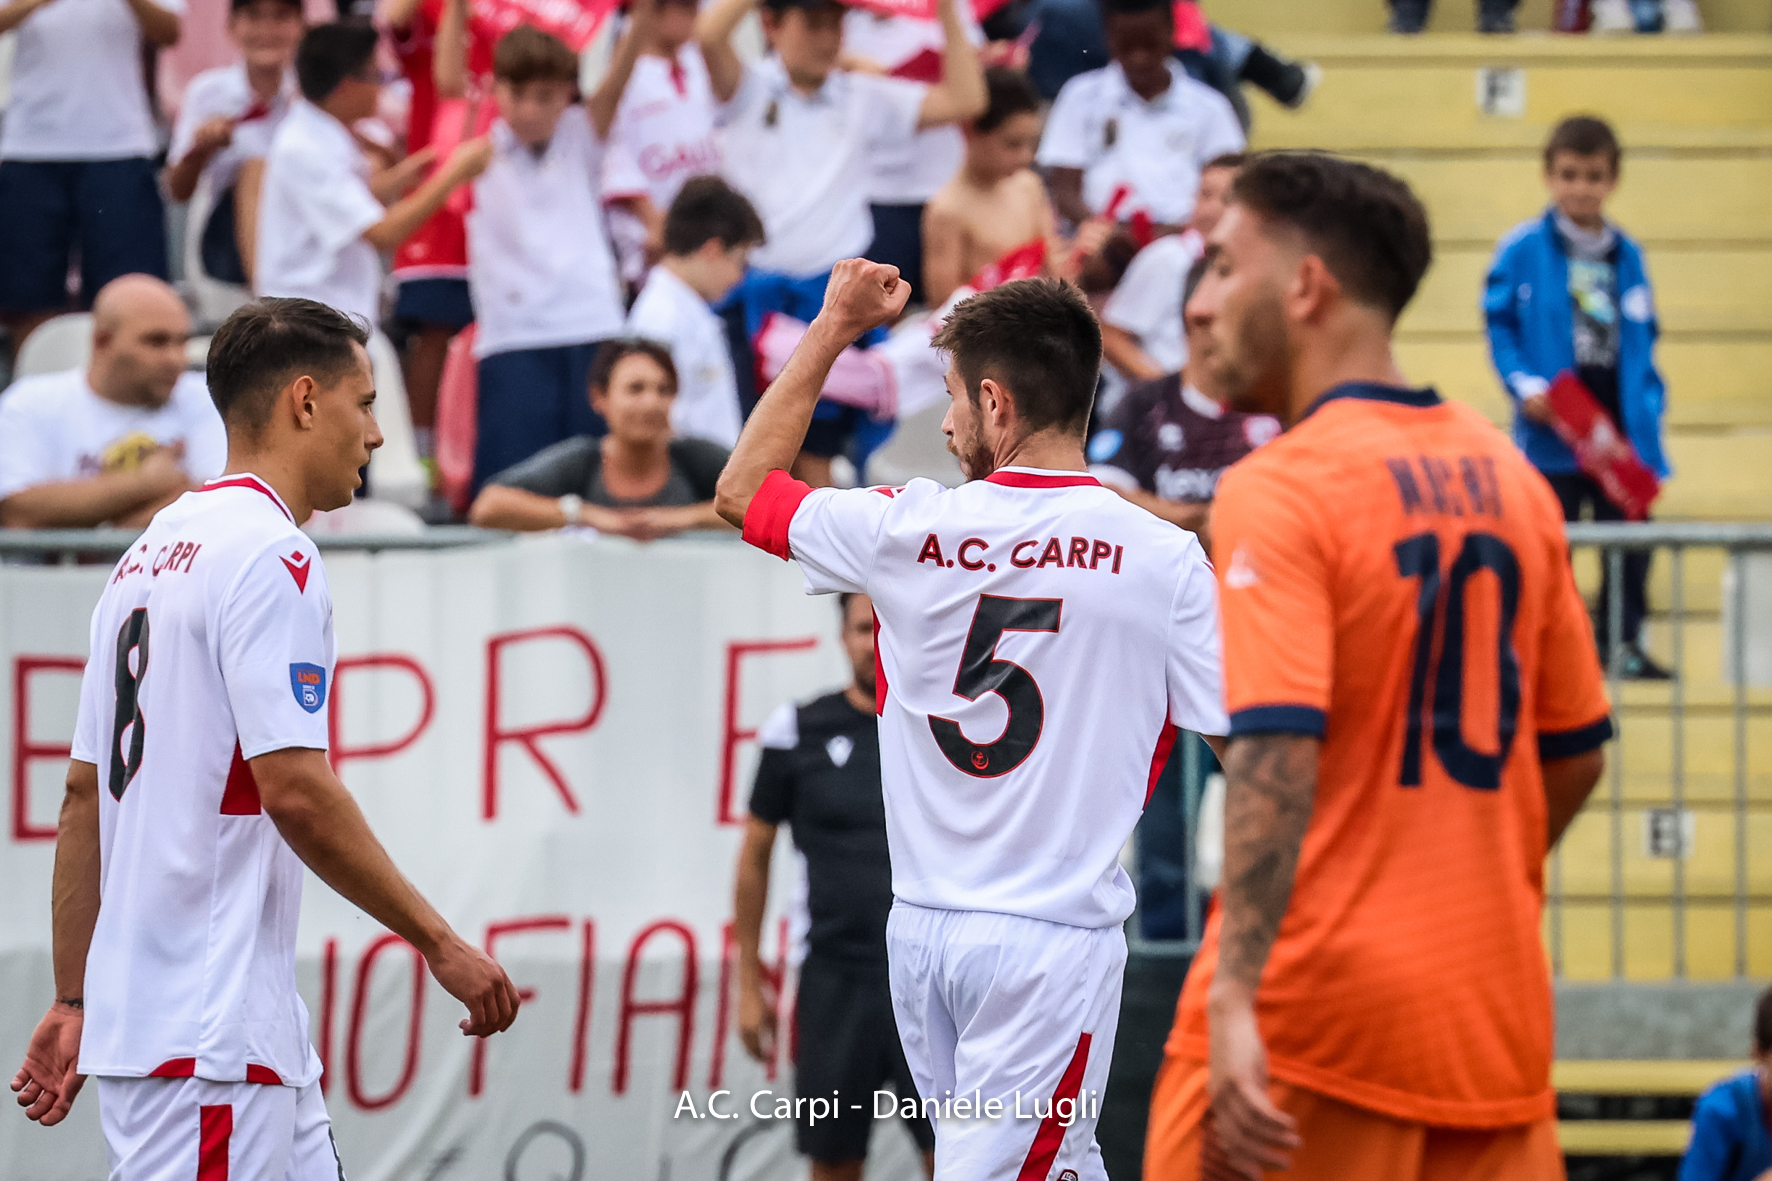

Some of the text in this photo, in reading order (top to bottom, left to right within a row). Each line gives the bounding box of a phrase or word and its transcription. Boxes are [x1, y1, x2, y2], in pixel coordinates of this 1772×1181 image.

[152, 541, 202, 577] CRPI
[917, 533, 1124, 575] A.C. CARPI
[10, 625, 819, 842] EPRE
[109, 606, 150, 803] 8
[927, 593, 1063, 779] 5
[1391, 529, 1522, 791] 10
